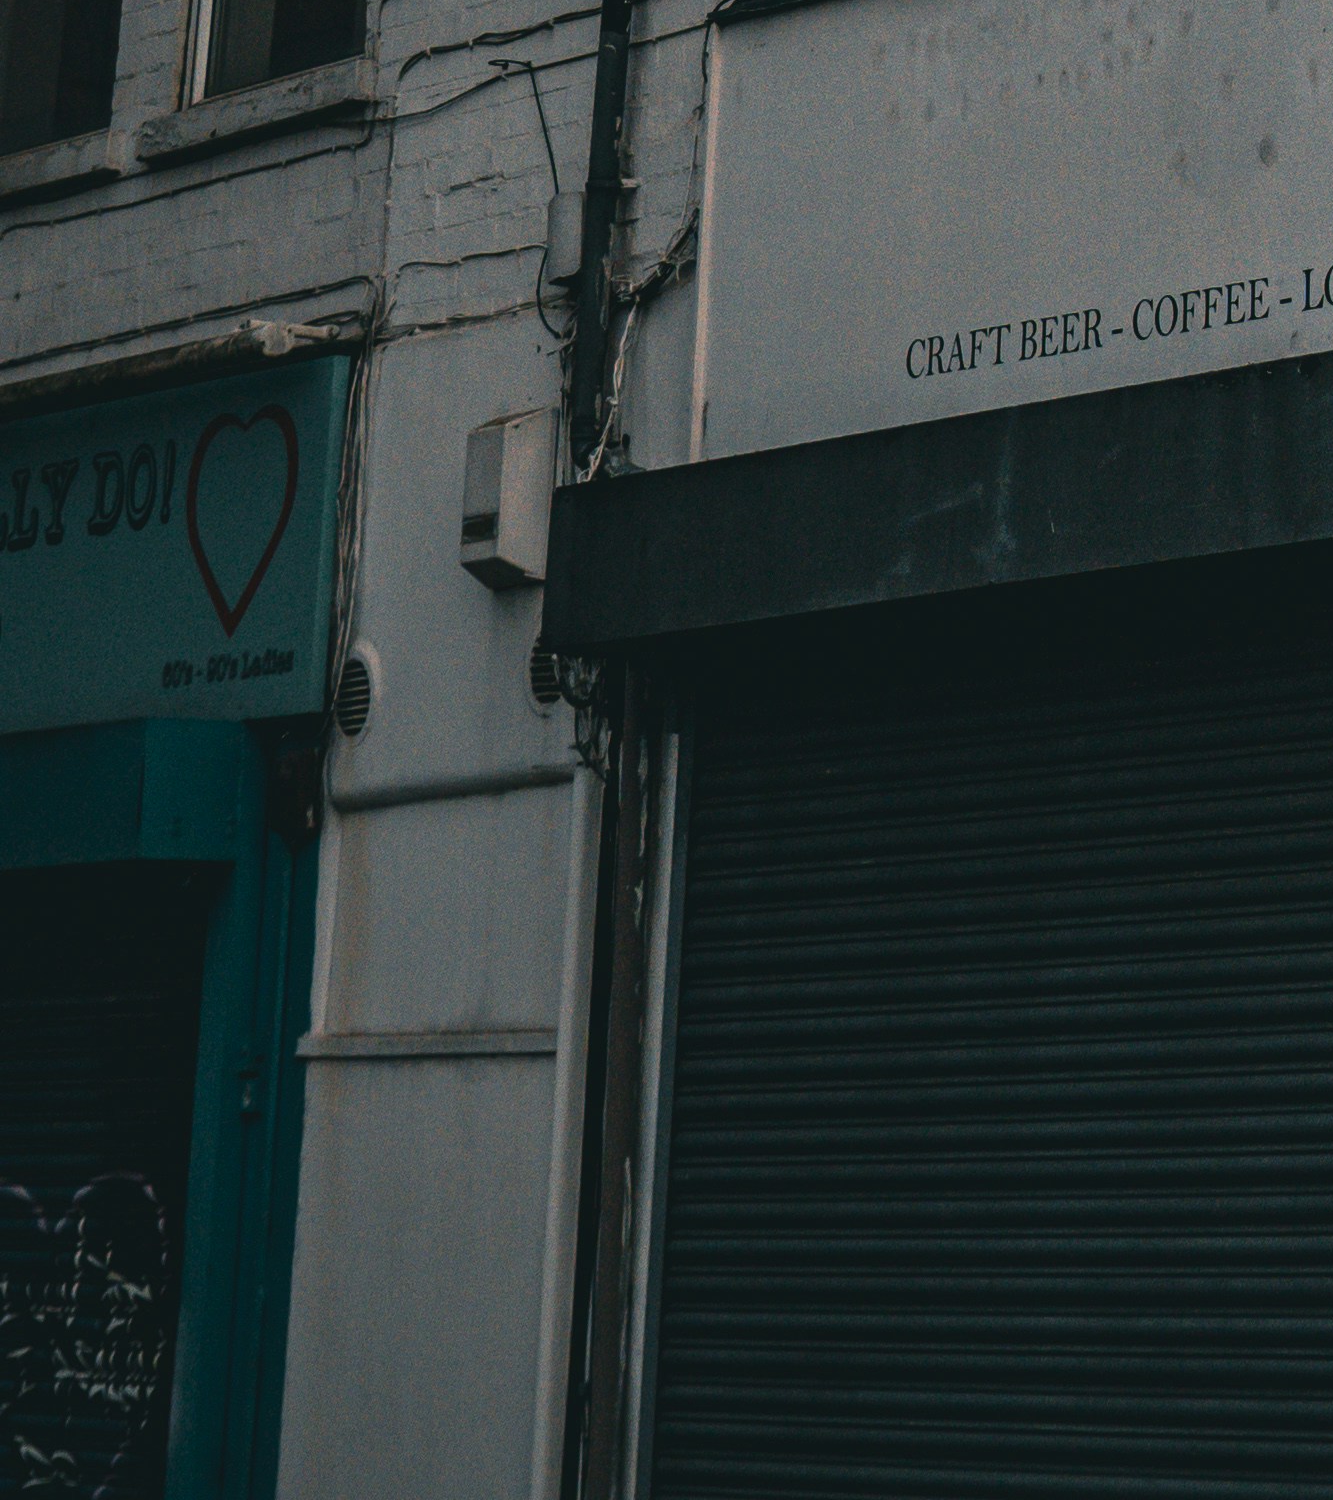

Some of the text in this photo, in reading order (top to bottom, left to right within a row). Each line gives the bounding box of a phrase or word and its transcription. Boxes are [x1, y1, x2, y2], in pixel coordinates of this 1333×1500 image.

[905, 324, 1011, 380] CRAFT
[1018, 308, 1103, 362] BEER
[1131, 279, 1271, 342] COFFEE
[0, 438, 177, 554] LY DO!
